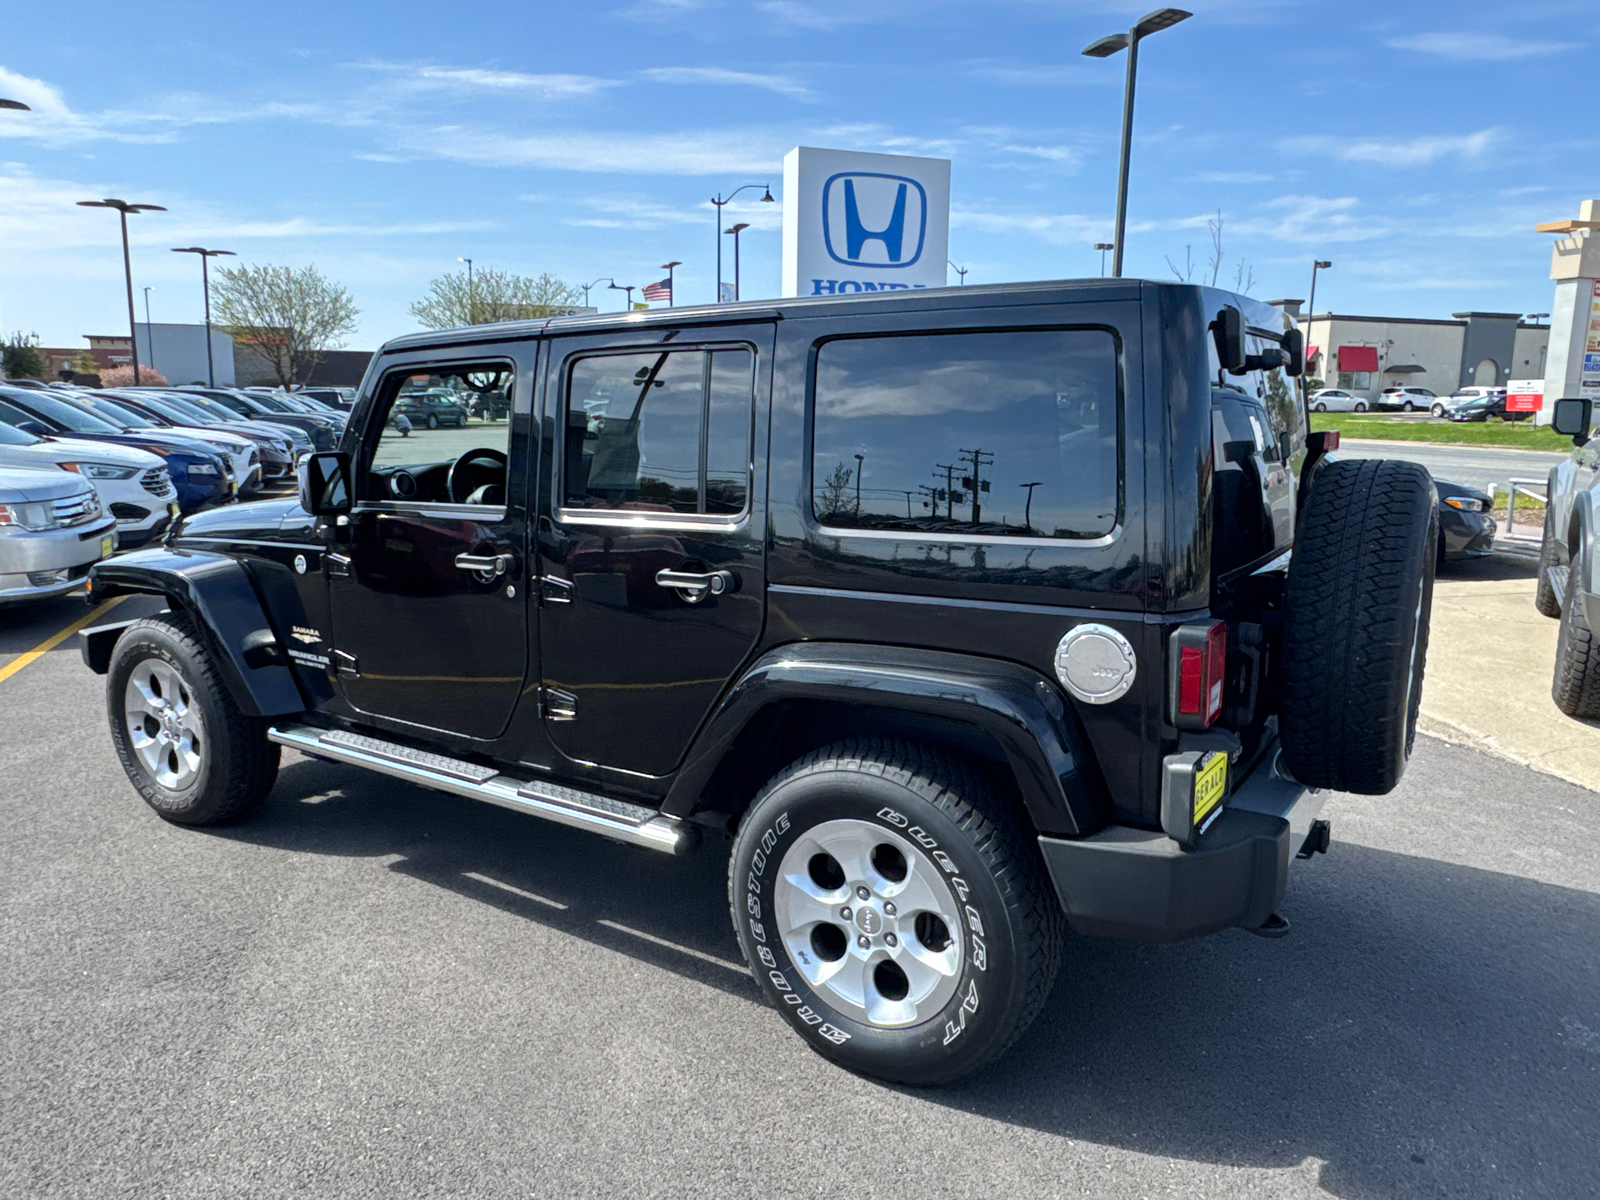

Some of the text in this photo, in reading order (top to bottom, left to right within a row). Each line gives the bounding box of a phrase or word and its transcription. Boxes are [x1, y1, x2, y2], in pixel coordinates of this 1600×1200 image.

[292, 625, 320, 636] SAHARA
[288, 648, 331, 664] WRANGLER
[1195, 766, 1224, 806] GERALD
[746, 811, 852, 1046] BRIDGESTONE
[876, 806, 988, 1047] DUELER A/T
